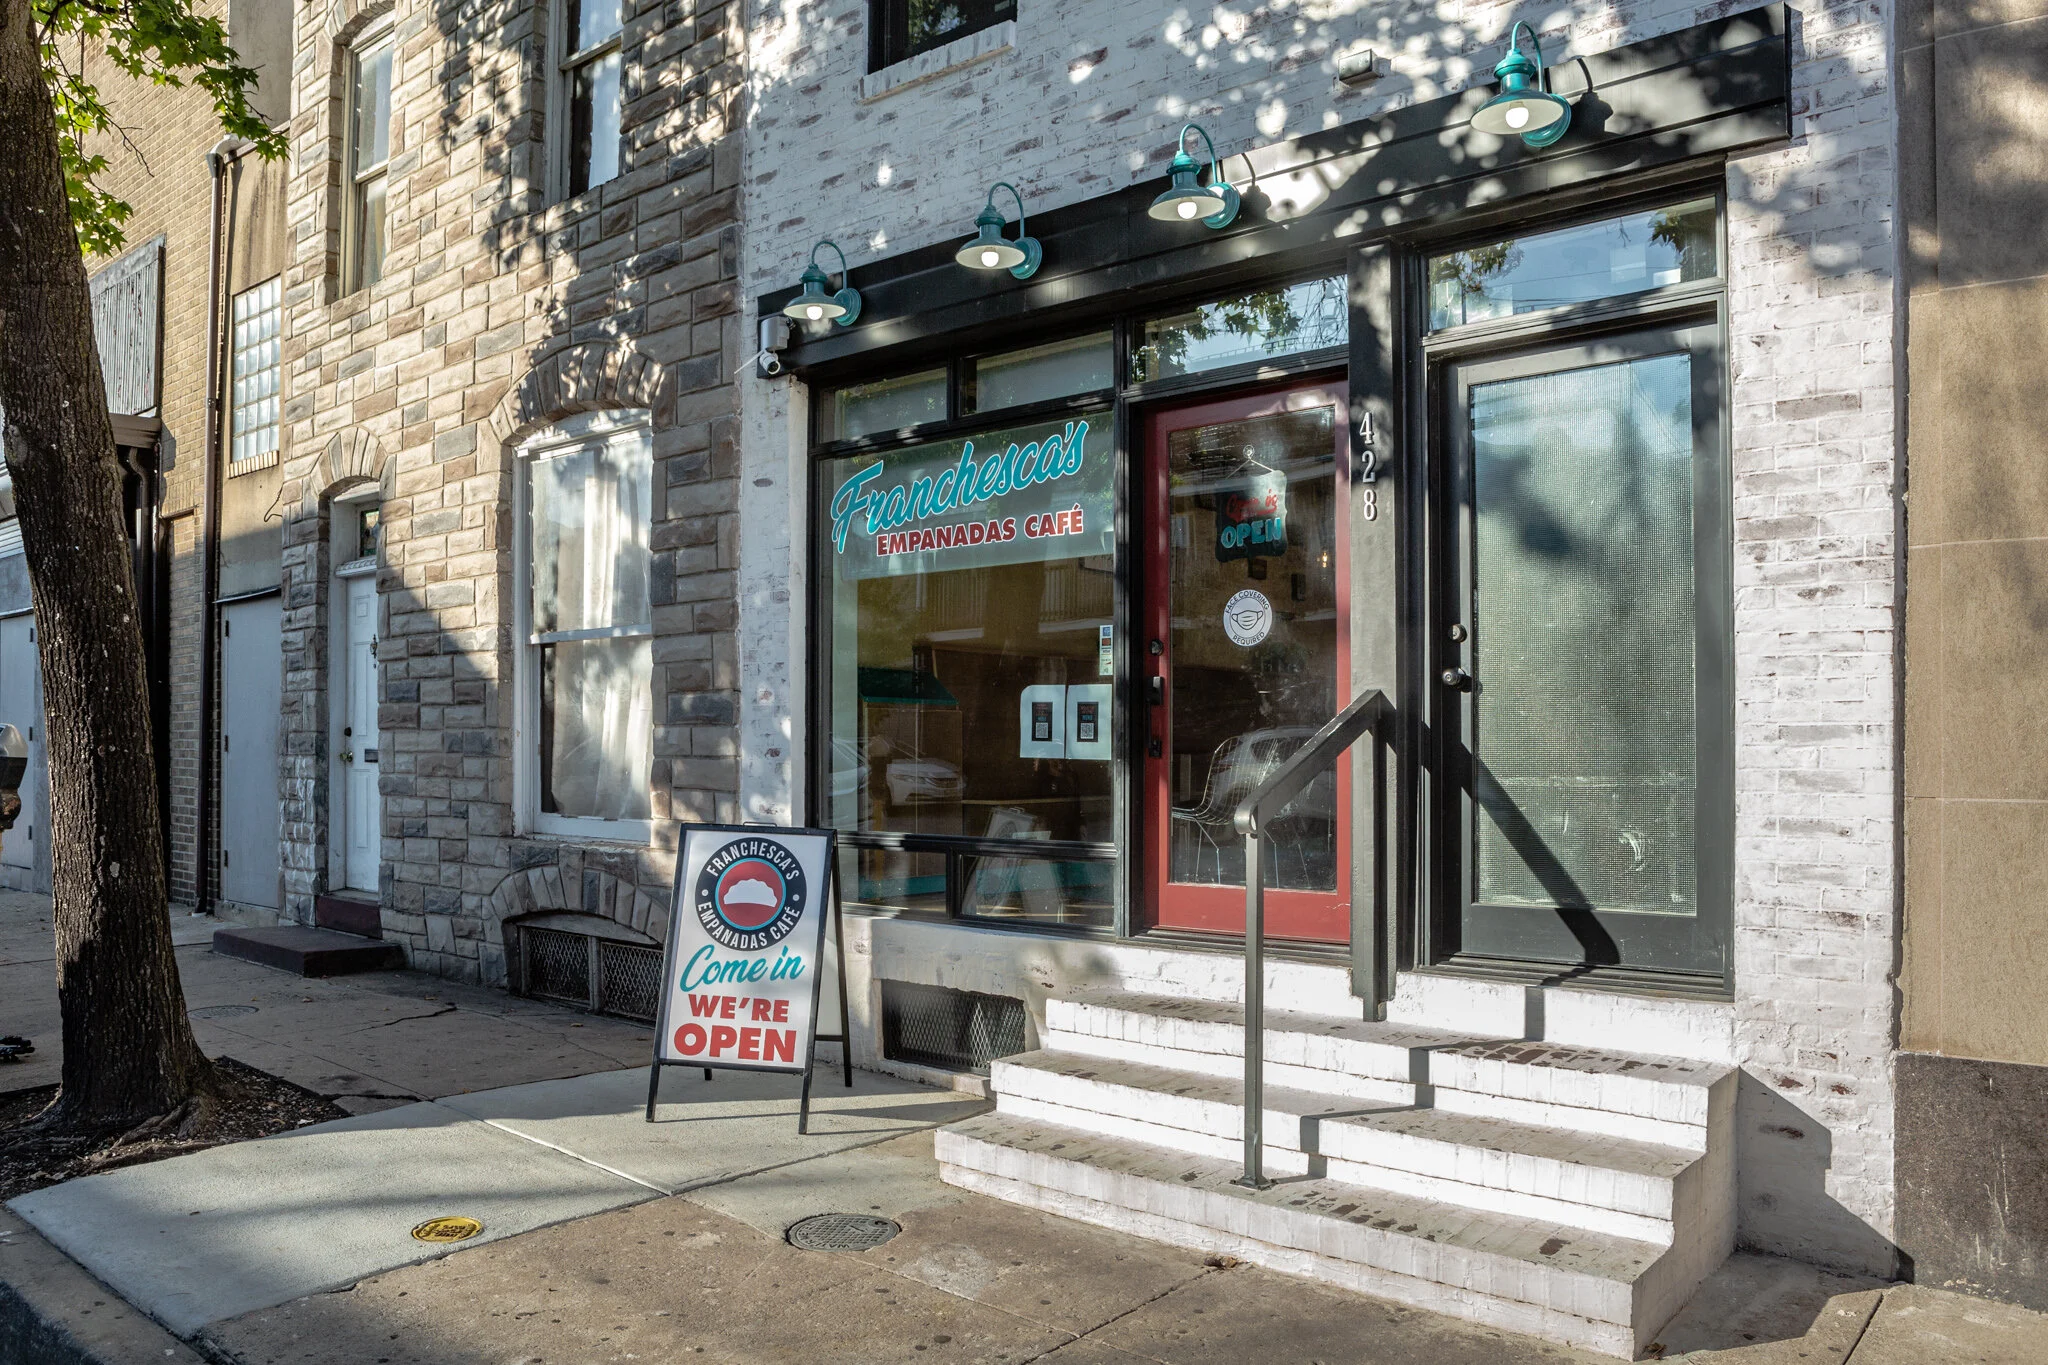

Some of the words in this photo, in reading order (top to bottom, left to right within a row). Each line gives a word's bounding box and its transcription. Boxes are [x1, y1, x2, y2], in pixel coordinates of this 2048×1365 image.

[831, 420, 1089, 554] Franchesca's
[1359, 411, 1377, 522] 428
[876, 517, 1016, 557] EMPANADAS
[1024, 503, 1084, 539] CAFÉ
[1221, 517, 1282, 549] OPEN
[1225, 596, 1239, 614] FACE
[1238, 590, 1270, 610] COVERING
[1232, 631, 1265, 646] REQUIRED
[706, 841, 800, 880] FRANCHESCA'S
[698, 901, 768, 949] EMPANADAS
[770, 905, 801, 940] CAFÉ
[680, 944, 768, 992] Come
[769, 945, 806, 981] in
[688, 993, 790, 1023] WE'RE
[673, 1022, 797, 1063] OPEN
